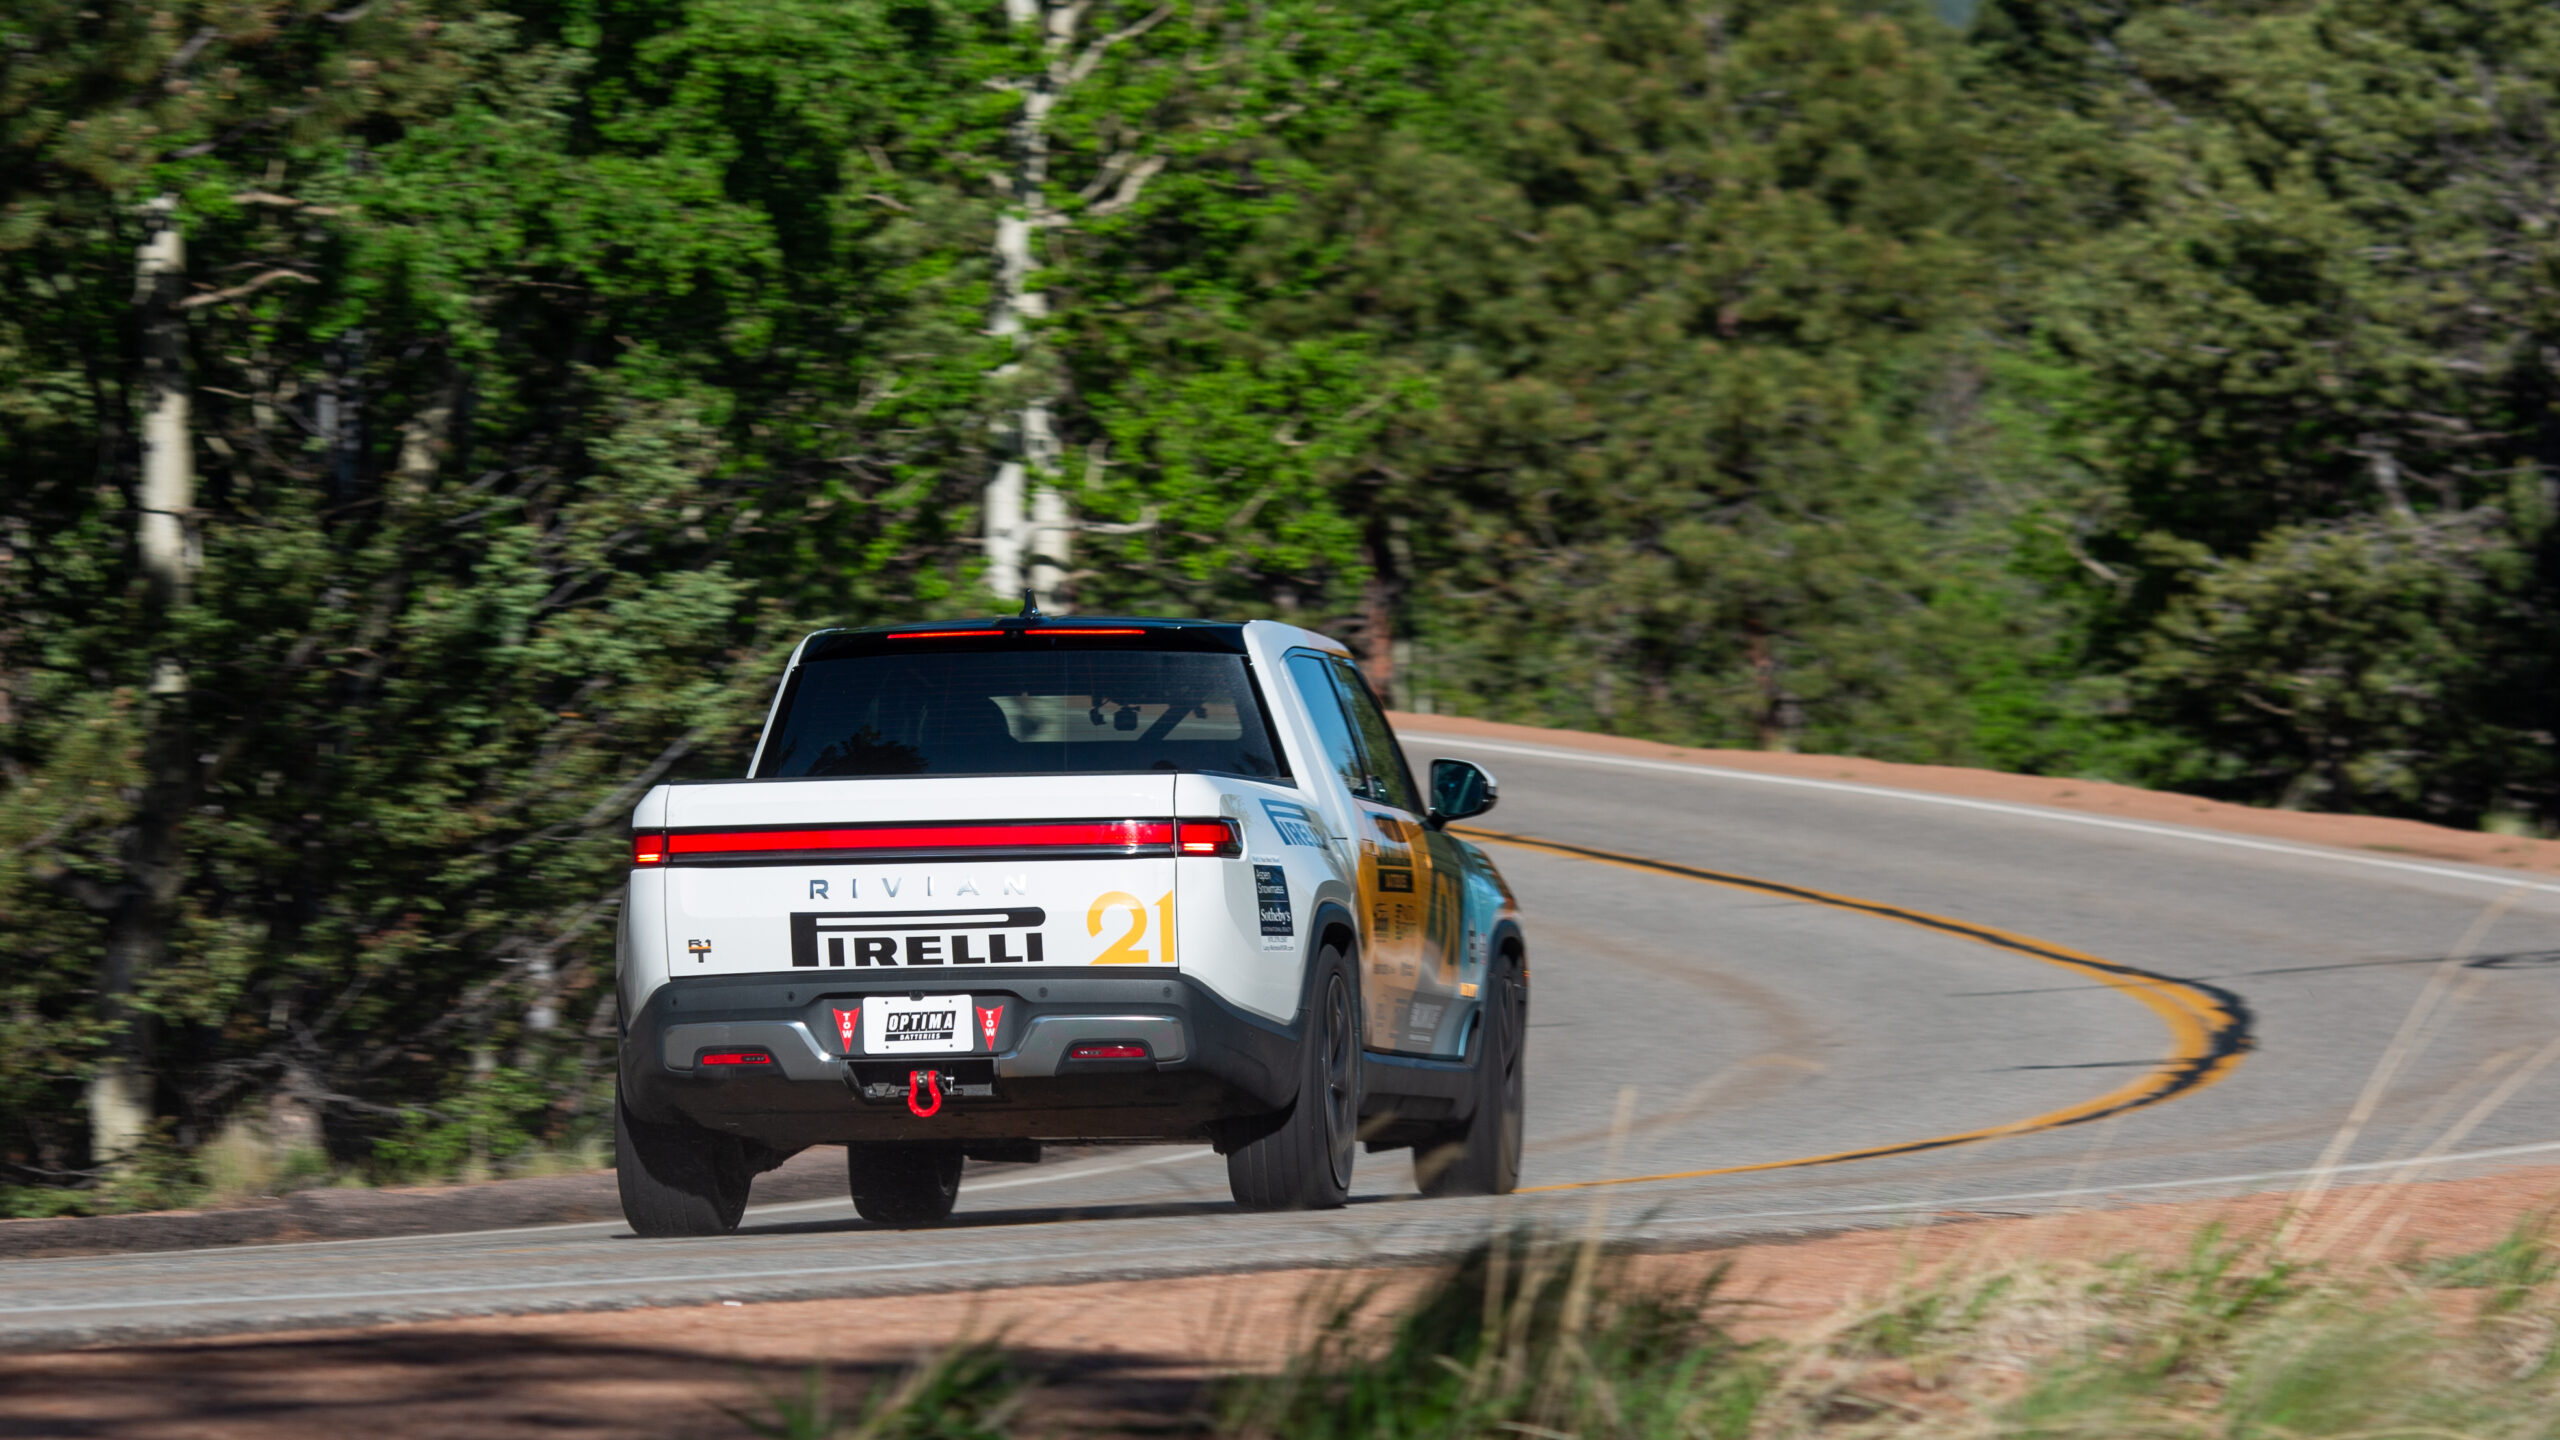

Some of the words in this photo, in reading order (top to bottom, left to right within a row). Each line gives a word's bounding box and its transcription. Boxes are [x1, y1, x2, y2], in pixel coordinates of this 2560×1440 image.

[809, 874, 1026, 900] RIVIAN
[1086, 889, 1176, 966] 21
[1260, 907, 1291, 925] Sotheby's
[789, 906, 1046, 967] PIRELLI
[842, 1012, 853, 1039] TOW
[887, 1011, 955, 1032] OPTIMA
[985, 1010, 995, 1037] TOW
[899, 1032, 941, 1041] BATTERIES
